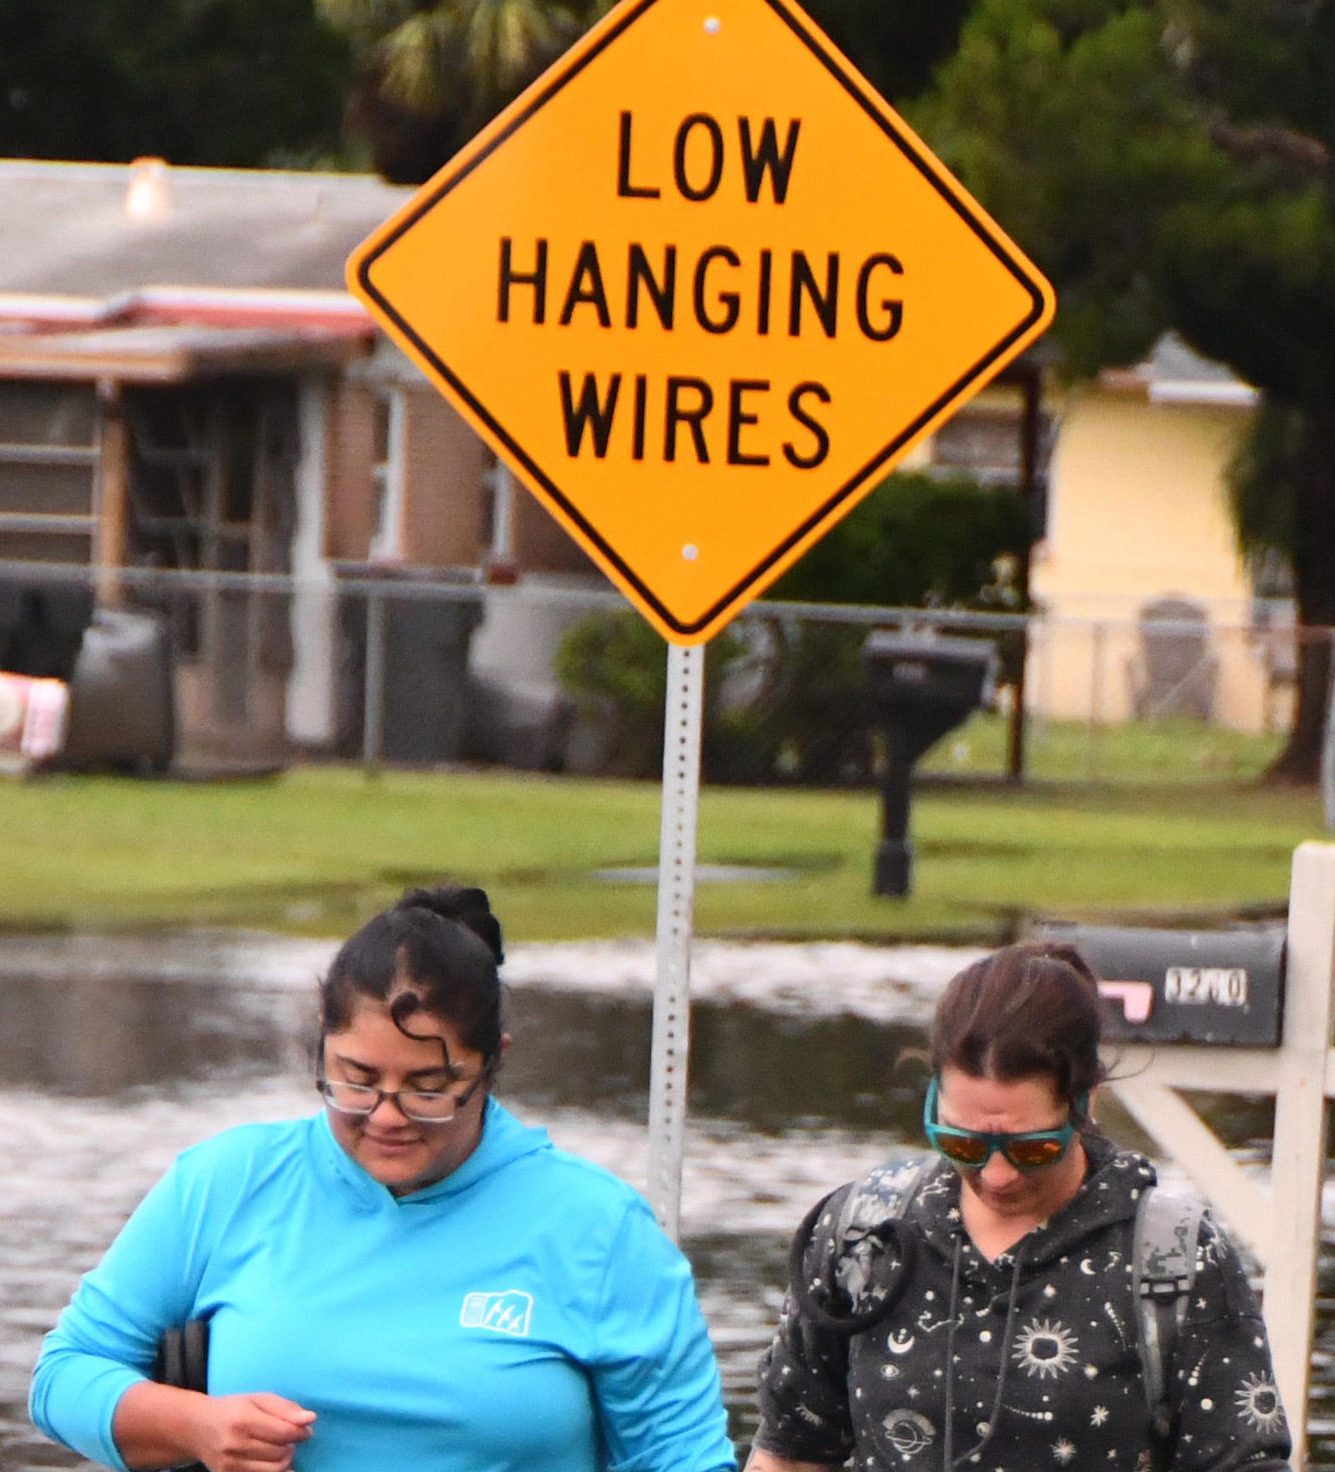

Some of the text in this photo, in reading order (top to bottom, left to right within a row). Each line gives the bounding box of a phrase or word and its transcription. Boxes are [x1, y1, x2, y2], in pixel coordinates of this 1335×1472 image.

[616, 110, 801, 205] LOW
[496, 237, 905, 342] HANGING
[557, 370, 832, 469] WIRES
